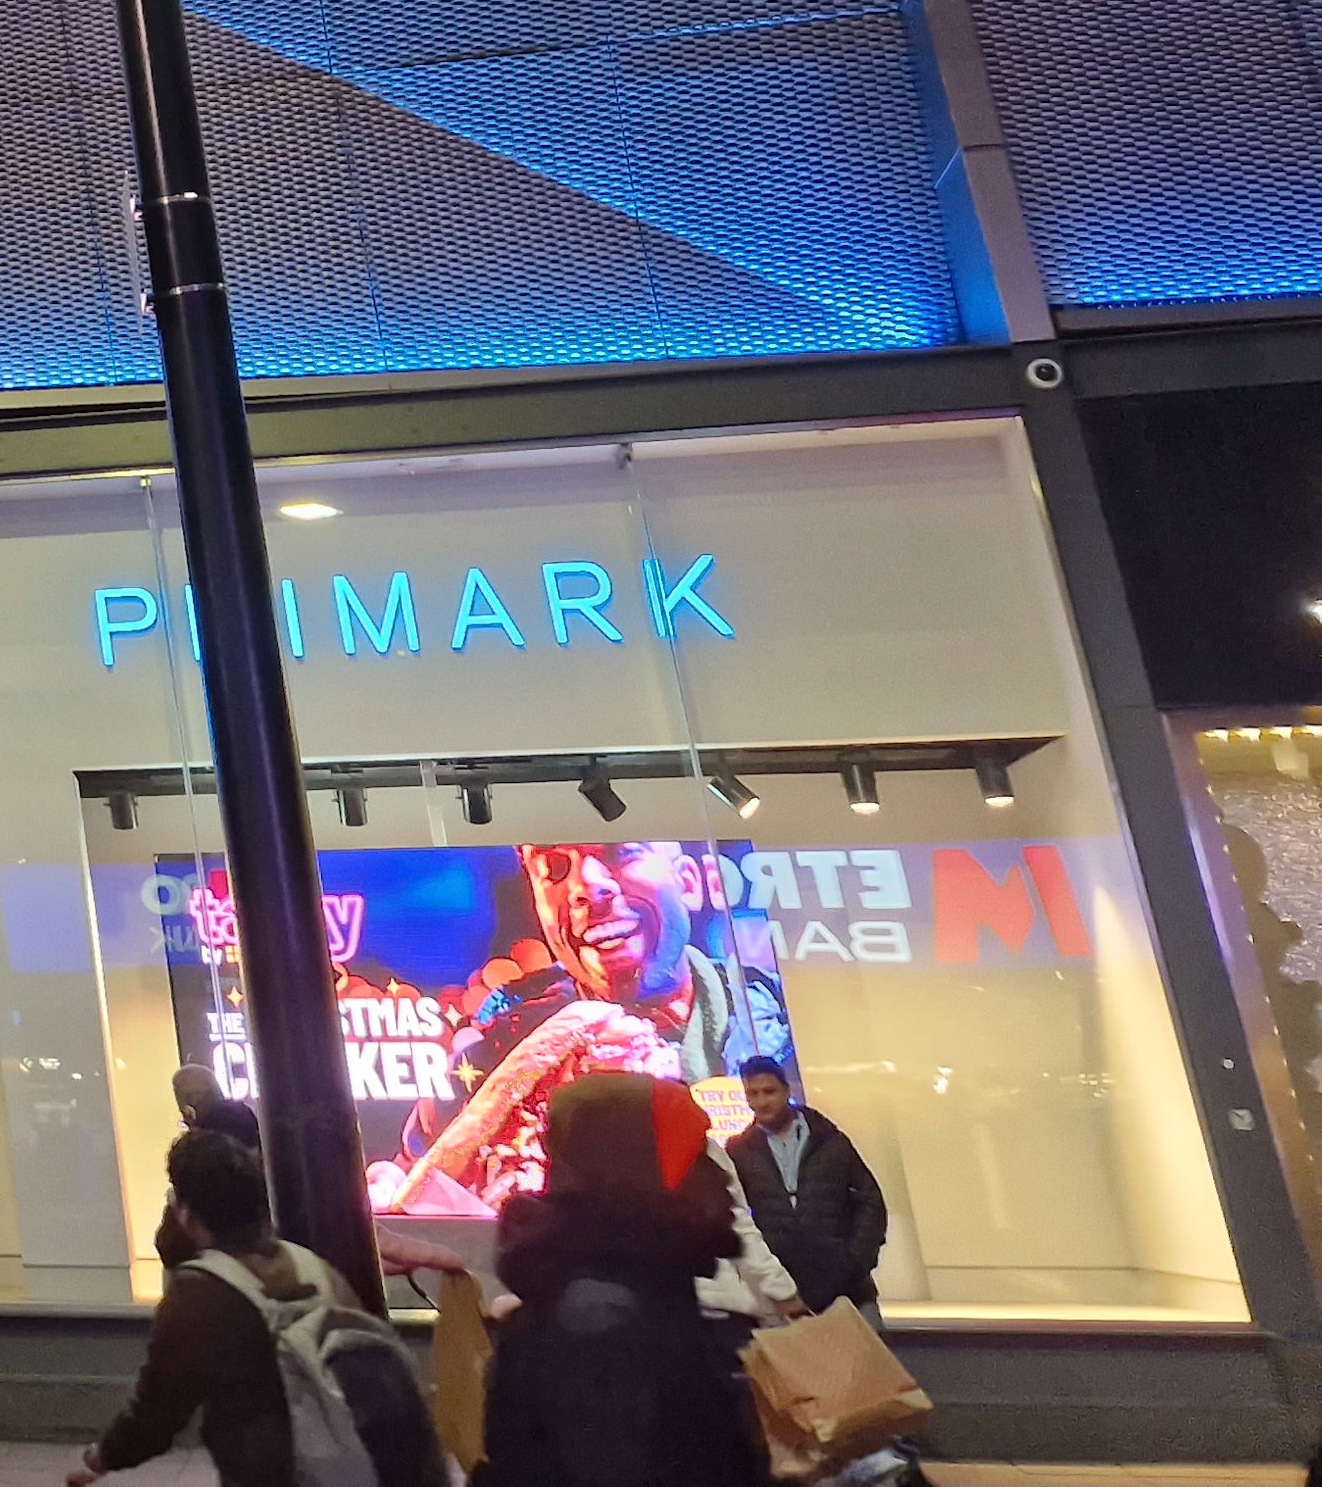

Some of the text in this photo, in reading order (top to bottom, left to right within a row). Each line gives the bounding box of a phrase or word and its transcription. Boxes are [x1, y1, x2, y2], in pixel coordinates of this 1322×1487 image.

[94, 553, 736, 666] PIMARK
[207, 1012, 246, 1036] THE
[213, 1042, 456, 1101] CKER
[700, 1090, 724, 1102] TRY
